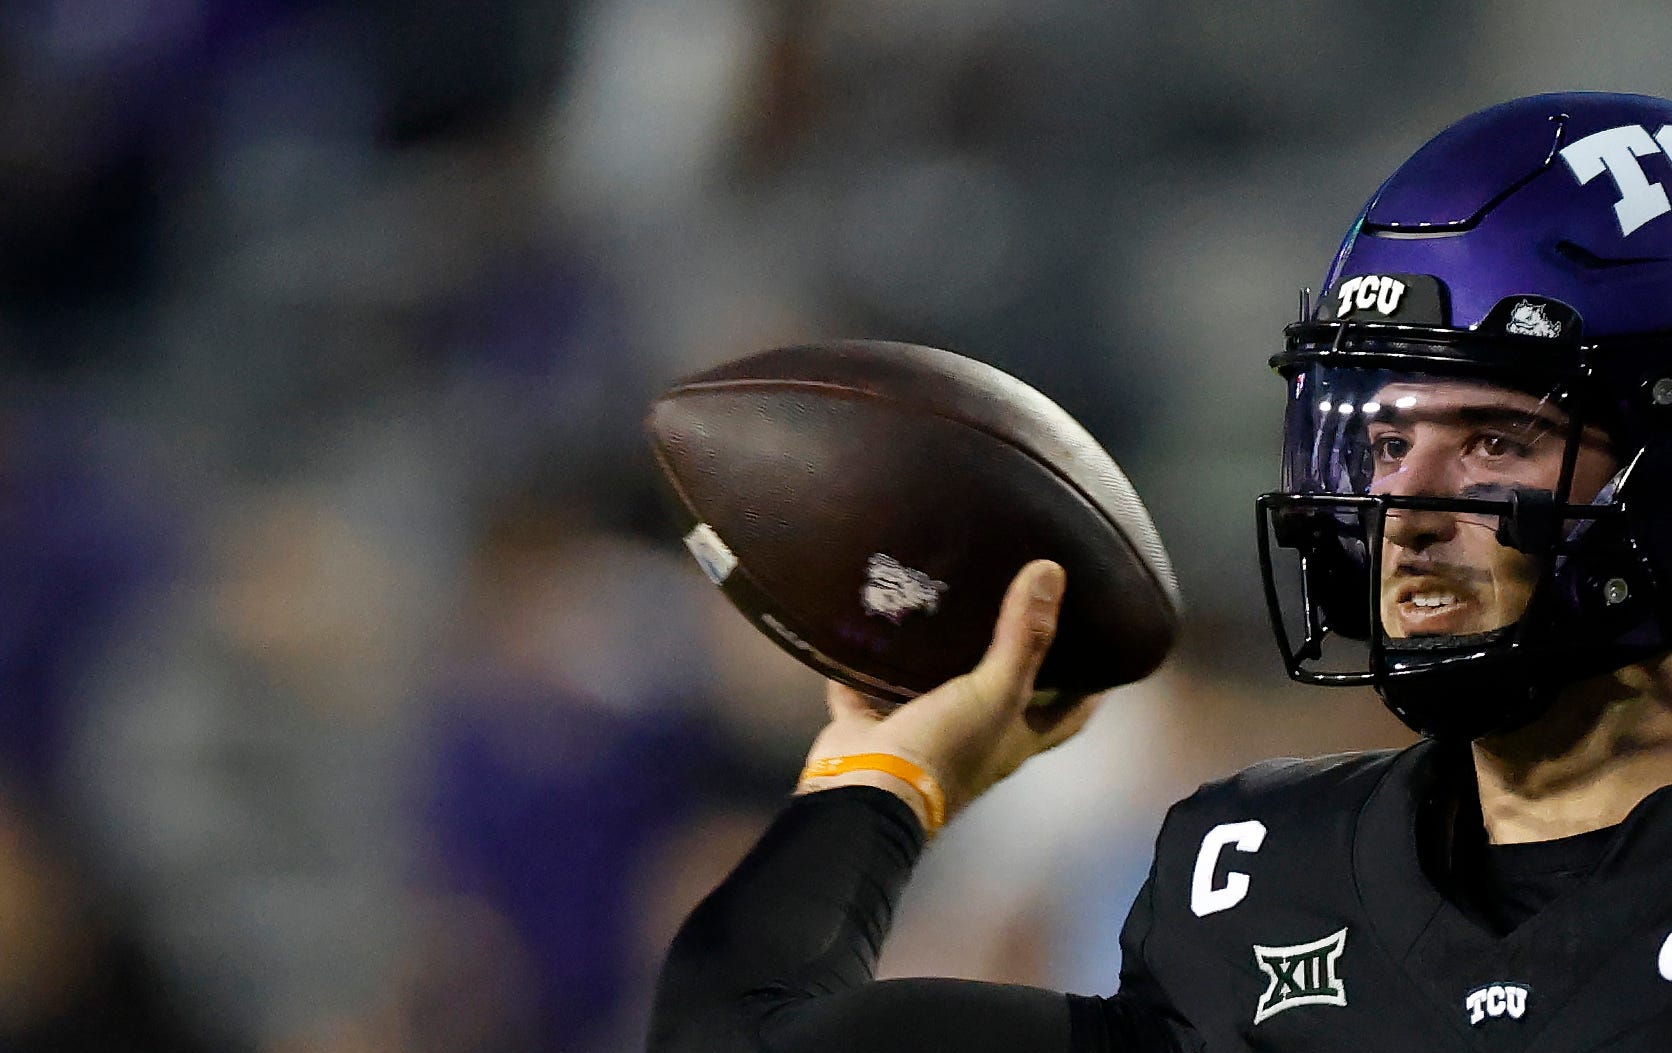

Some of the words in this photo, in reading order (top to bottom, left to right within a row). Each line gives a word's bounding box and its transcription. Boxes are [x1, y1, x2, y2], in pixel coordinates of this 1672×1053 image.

[1337, 275, 1405, 318] TCU
[1190, 820, 1267, 917] C
[1260, 936, 1340, 1014] XII
[1465, 984, 1529, 1026] TCU
